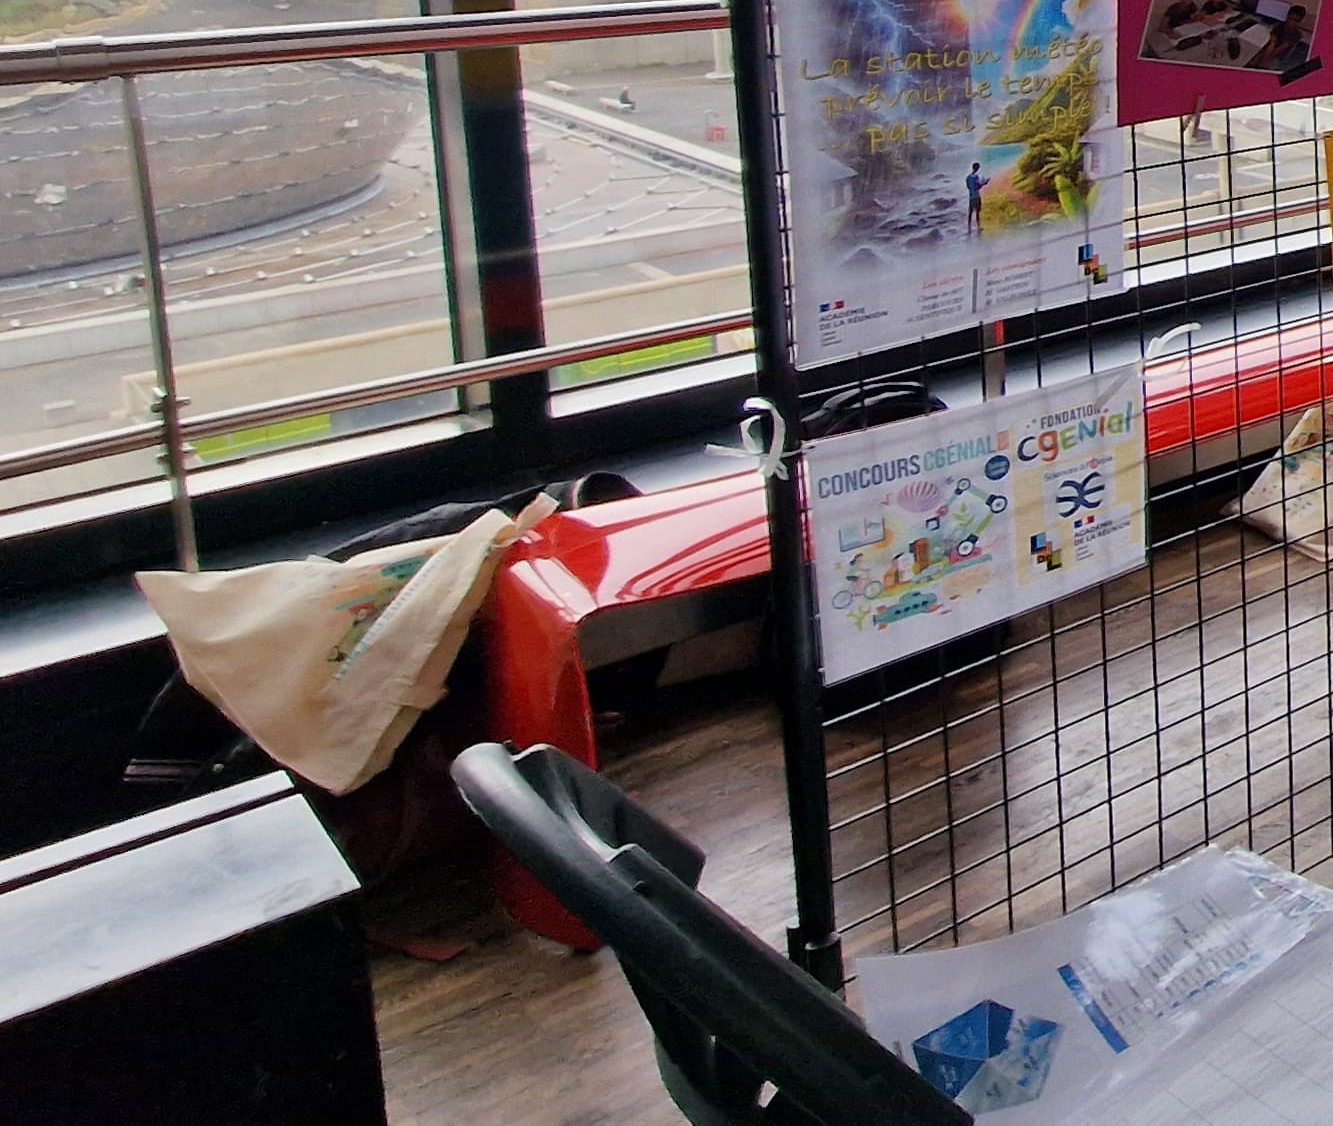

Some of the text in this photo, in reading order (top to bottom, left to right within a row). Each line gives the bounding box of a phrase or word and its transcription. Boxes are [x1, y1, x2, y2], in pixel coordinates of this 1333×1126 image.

[866, 44, 1001, 76] station
[965, 78, 993, 100] le
[817, 454, 921, 500] CONCOURS
